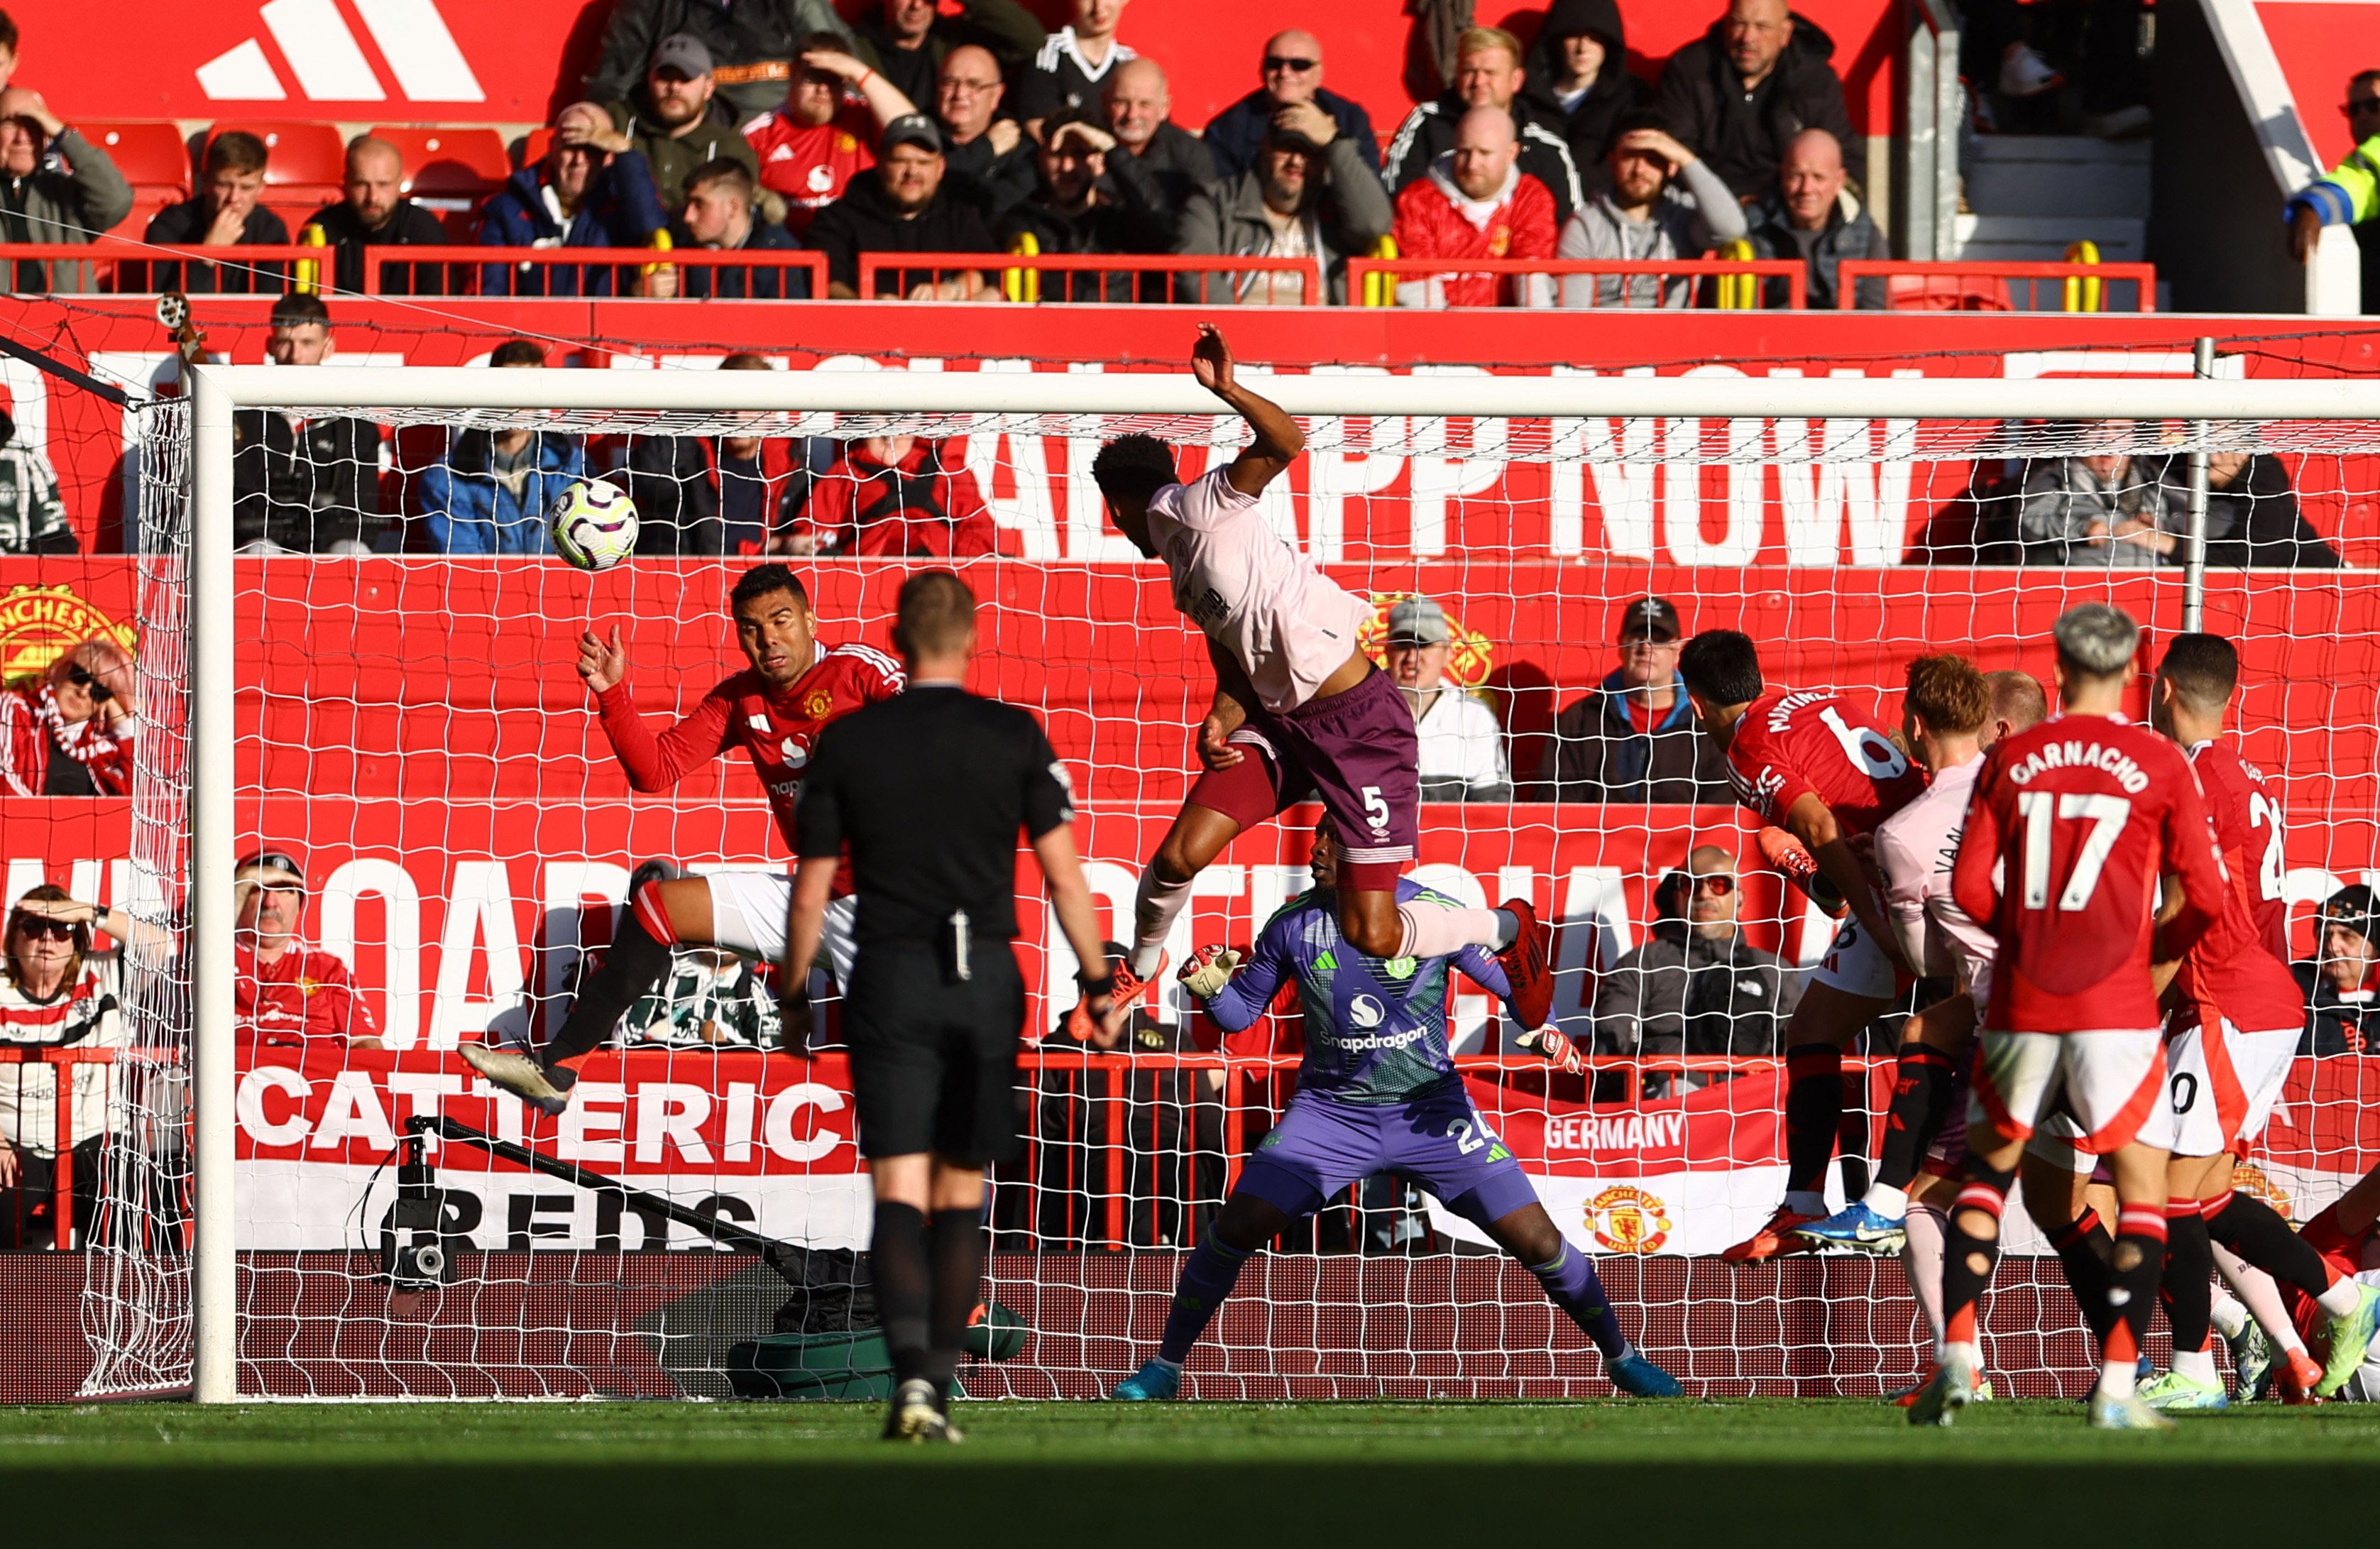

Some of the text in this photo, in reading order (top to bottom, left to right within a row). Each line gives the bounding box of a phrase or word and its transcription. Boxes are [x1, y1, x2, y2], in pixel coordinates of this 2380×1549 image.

[1550, 364, 1923, 566] NOW
[1819, 706, 1907, 779] 6
[2009, 740, 2150, 794] GARNACHO
[1361, 785, 1389, 828] 5
[2017, 791, 2131, 912] 17
[1320, 1025, 1427, 1053] Snapdragon
[236, 1065, 860, 1164] CATTERIC
[1545, 1113, 1683, 1150] GERMANY
